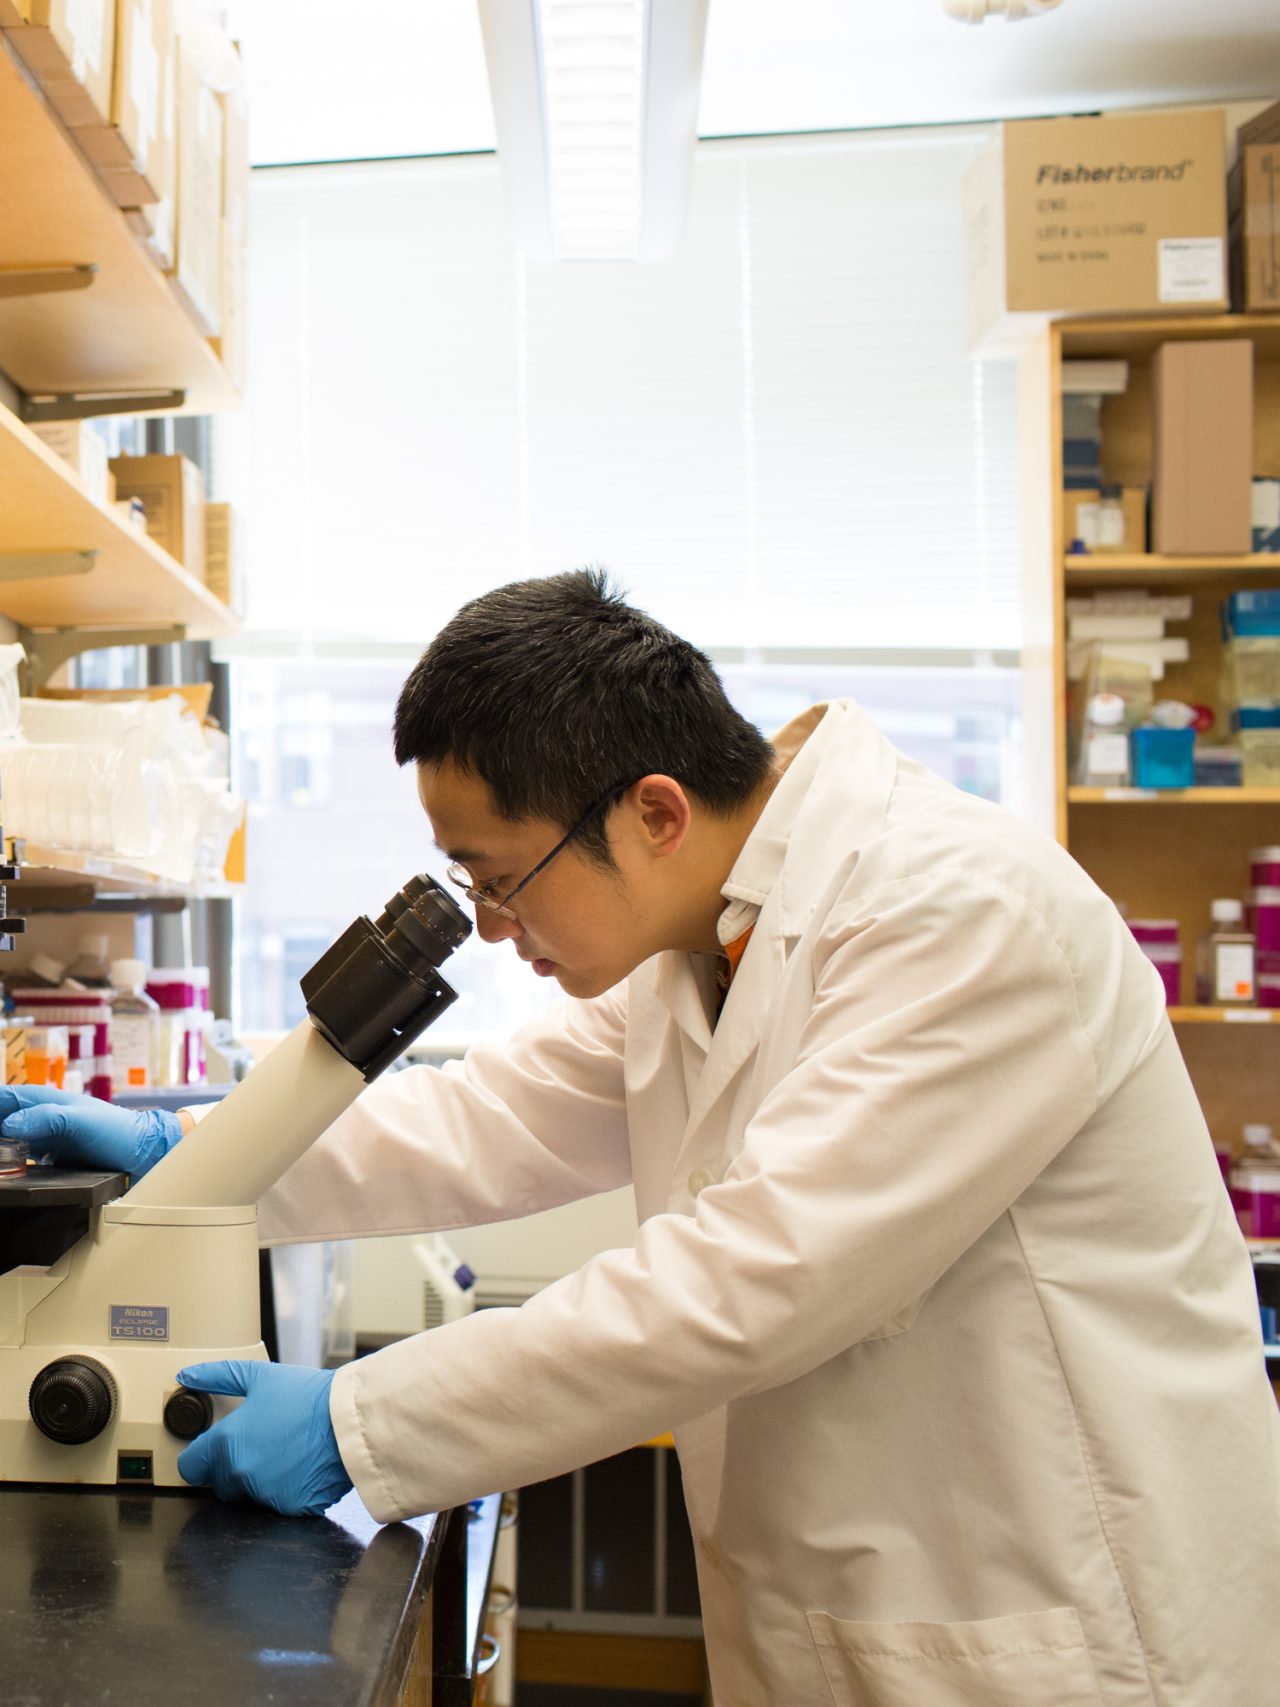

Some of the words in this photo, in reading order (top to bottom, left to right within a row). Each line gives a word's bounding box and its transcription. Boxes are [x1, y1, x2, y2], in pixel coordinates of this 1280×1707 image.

[1036, 160, 1185, 186] Fisherbrand
[124, 1308, 154, 1318] Nikon
[119, 1318, 159, 1326] ECLIPSE
[112, 1326, 166, 1337] TS100
